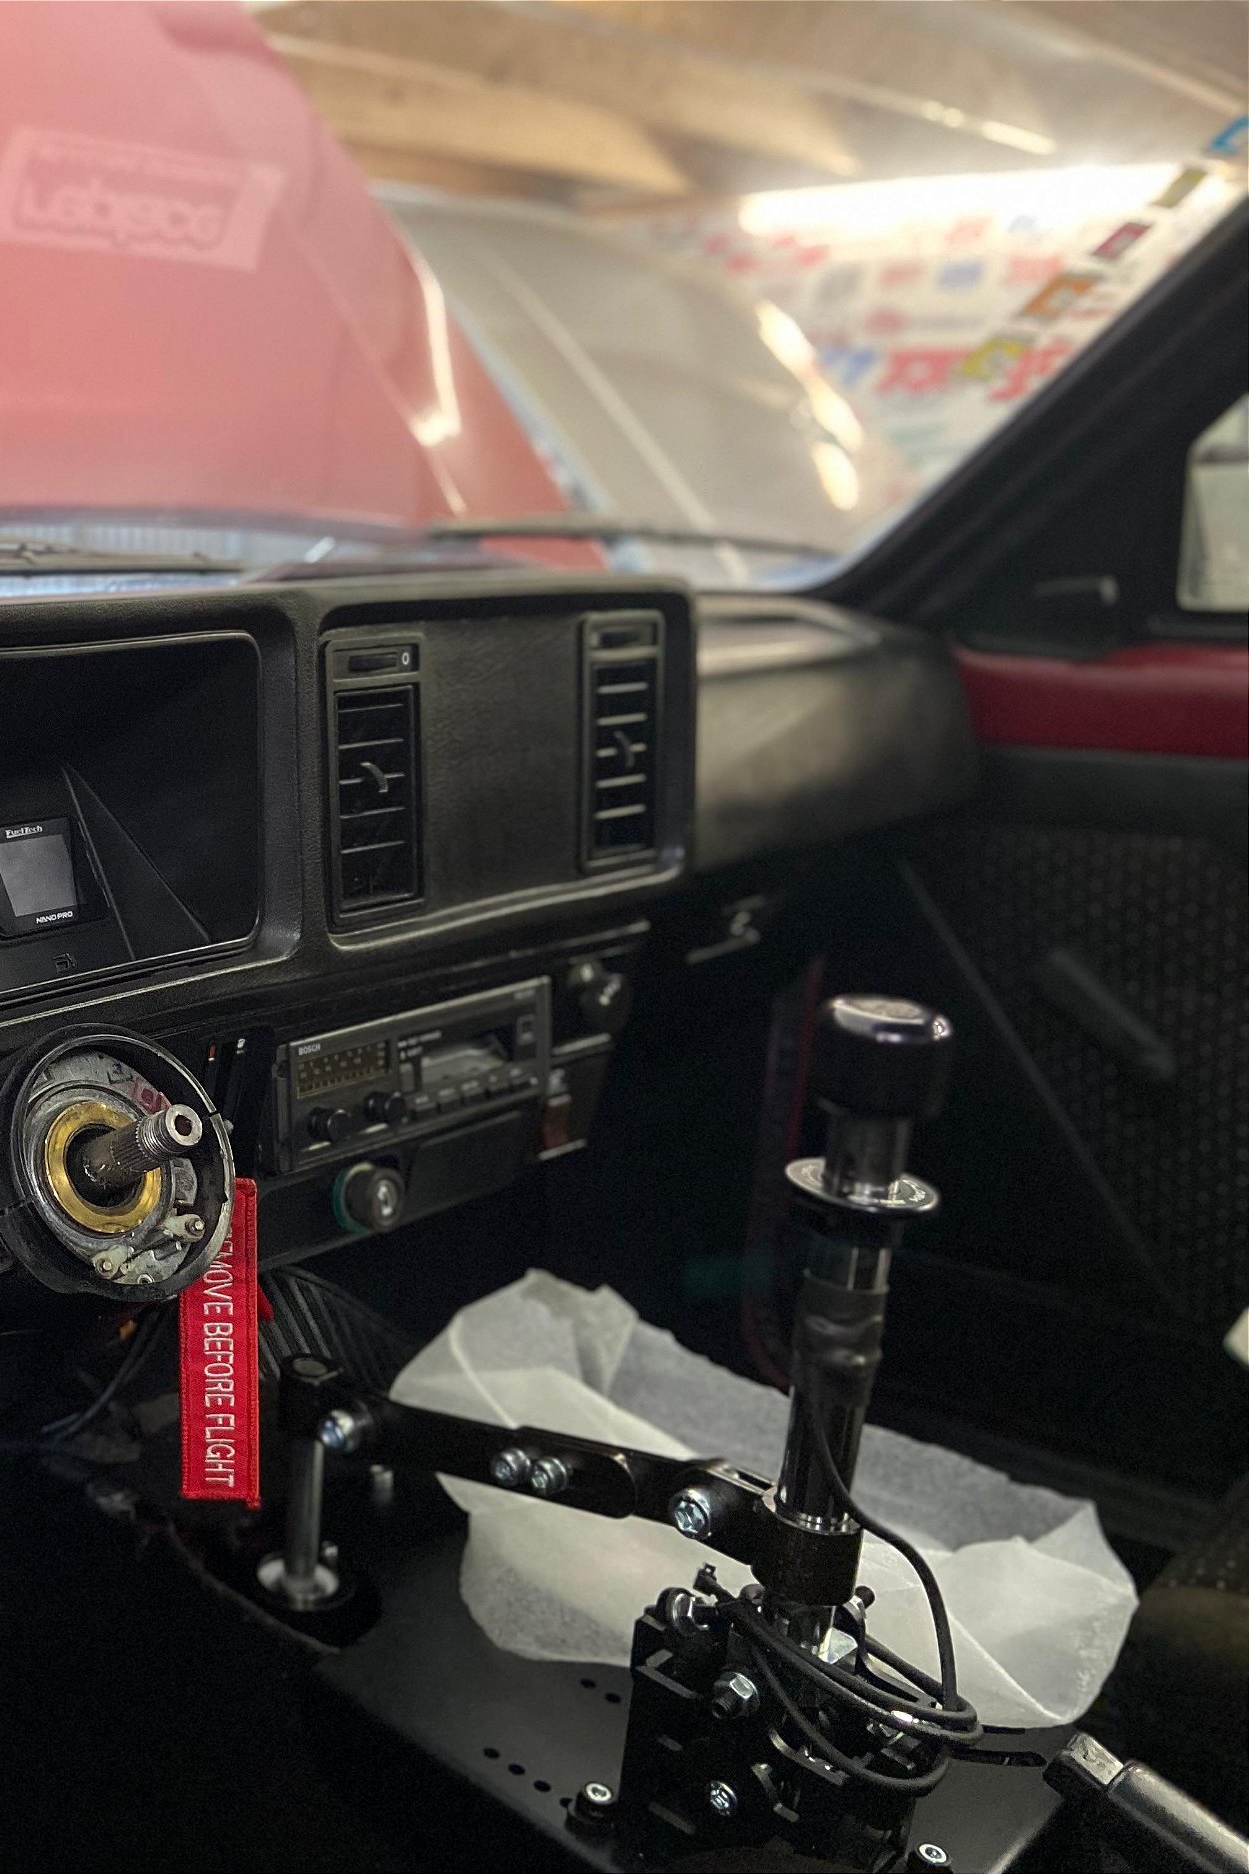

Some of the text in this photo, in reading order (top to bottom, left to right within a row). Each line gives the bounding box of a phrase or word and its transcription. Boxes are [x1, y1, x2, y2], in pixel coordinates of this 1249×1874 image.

[4, 824, 43, 839] FuelTech
[36, 910, 74, 925] NANO PRO
[298, 1042, 321, 1056] BOSCH
[203, 1322, 235, 1408] BEFORE
[204, 1413, 236, 1488] FLIGHT
